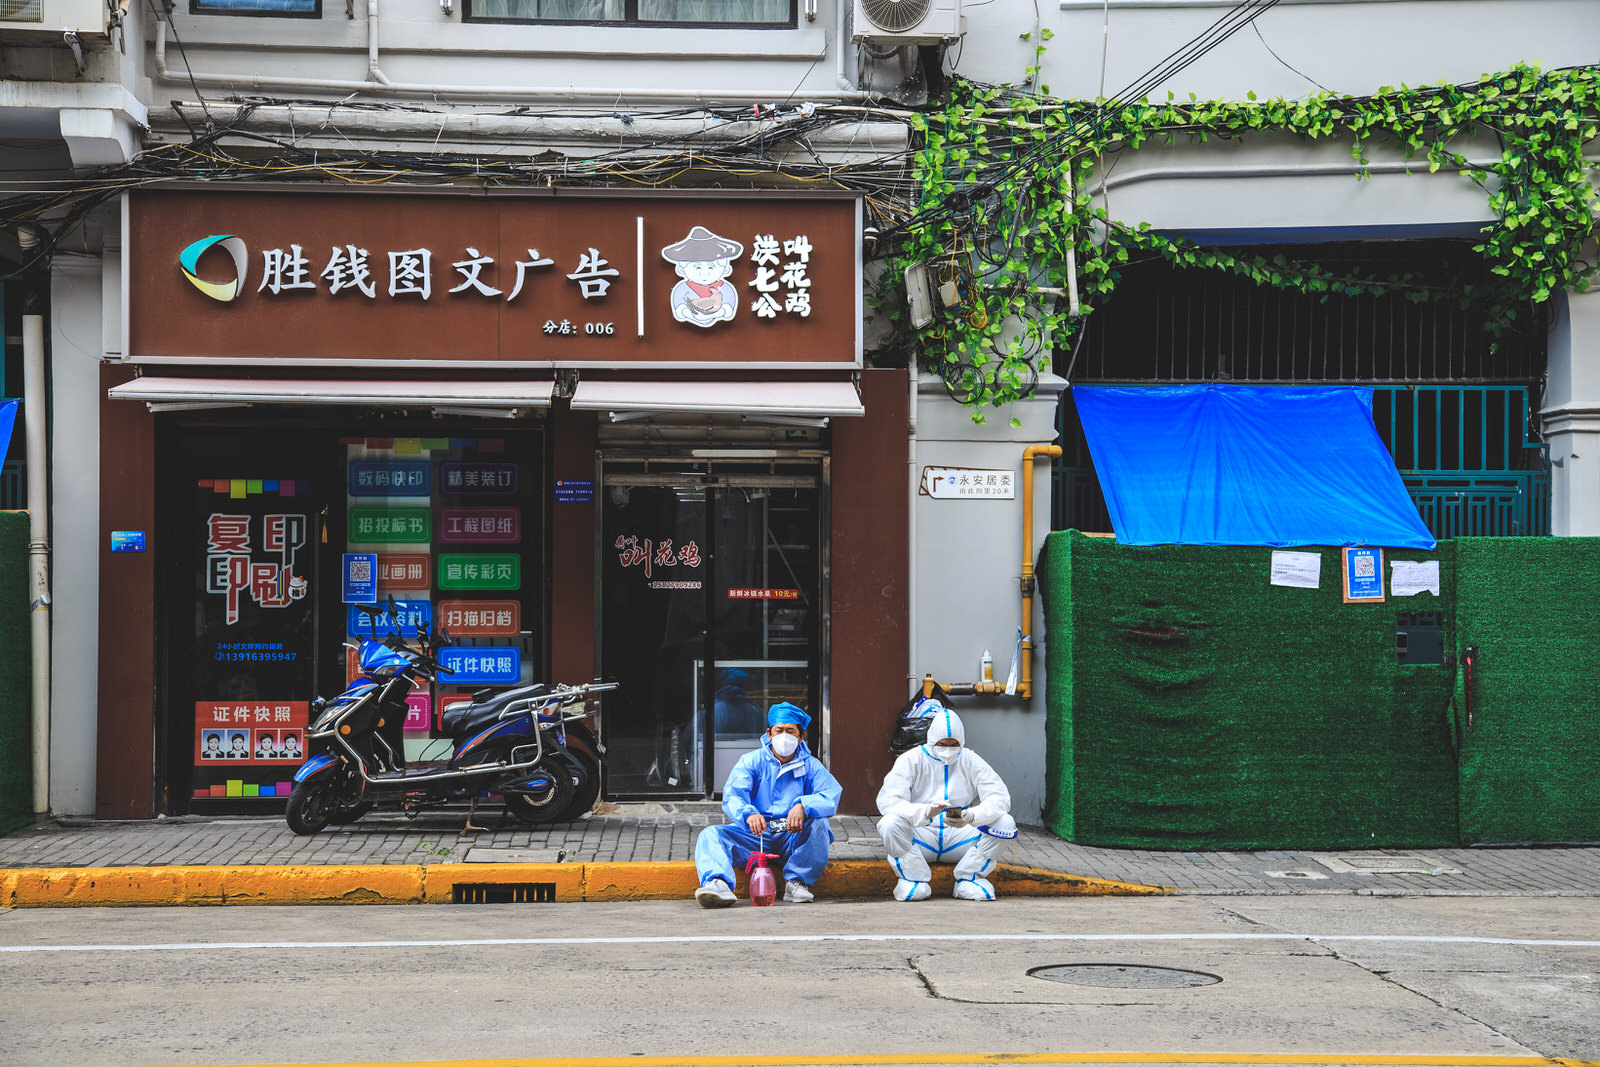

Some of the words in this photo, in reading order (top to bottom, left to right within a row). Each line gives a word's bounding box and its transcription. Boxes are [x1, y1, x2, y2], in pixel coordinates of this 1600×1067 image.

[257, 244, 620, 301] 胜钱图文广告
[358, 470, 423, 487] 数码快印
[448, 470, 513, 487] 精美装订
[959, 474, 1011, 486] 永安居委
[358, 517, 423, 534] 招投标书
[448, 517, 512, 534] 工程图纸
[207, 513, 306, 568] 复印
[619, 538, 701, 578] 叫花鸡
[378, 563, 422, 580] 业画册
[447, 563, 512, 580] 宣传彩页
[207, 554, 294, 625] 印刷
[358, 610, 422, 627] 会议资料
[447, 610, 512, 627] 扫描归档
[226, 652, 297, 661] 13916395947
[447, 657, 512, 673] 证件快照
[213, 706, 291, 723] 证件快照
